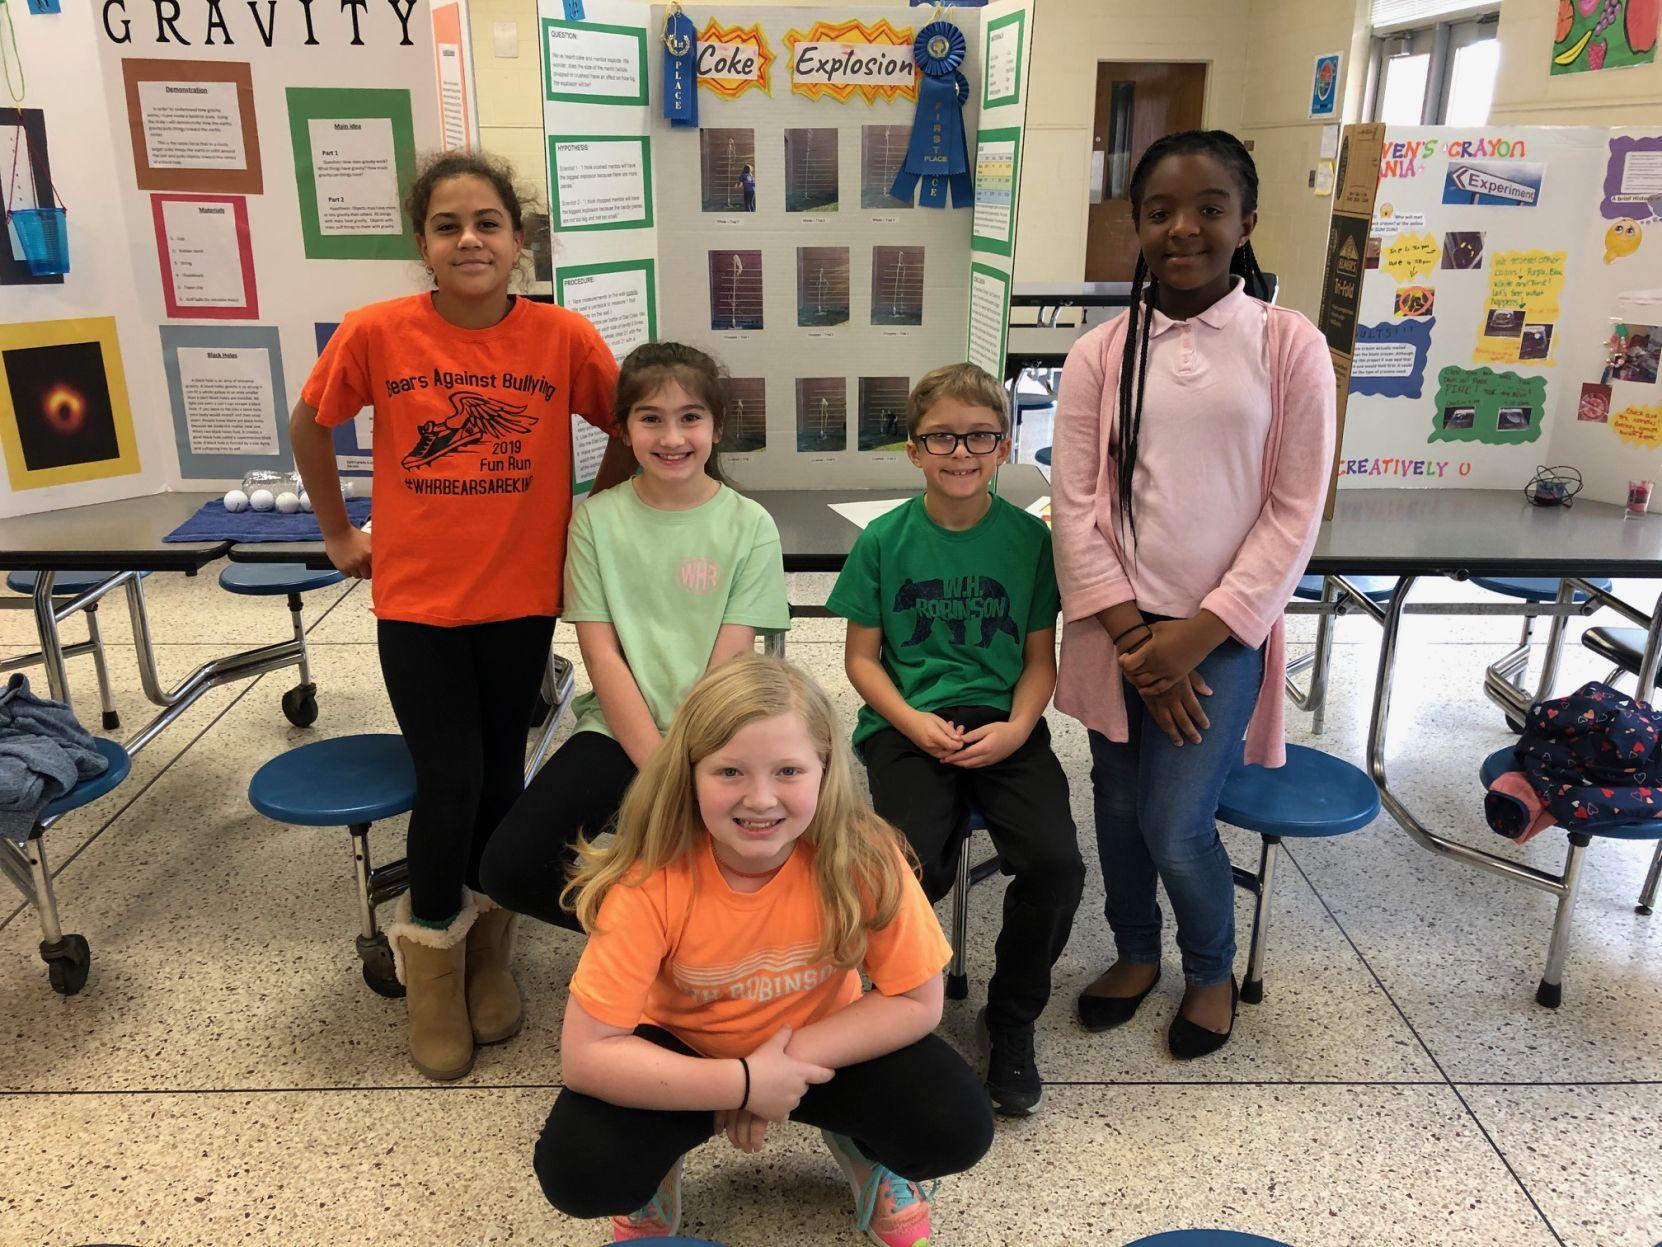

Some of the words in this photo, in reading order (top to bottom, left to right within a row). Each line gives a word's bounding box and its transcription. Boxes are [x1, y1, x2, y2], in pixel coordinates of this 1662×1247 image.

[103, 0, 417, 47] GRAVITY
[696, 43, 755, 78] Coke
[795, 46, 913, 83] Explosion
[674, 60, 685, 111] PLACE
[334, 123, 348, 131] Main
[1467, 174, 1537, 201] Experiment
[434, 368, 497, 389] Against
[502, 373, 556, 402] Bullying
[492, 440, 522, 455] 2019
[480, 458, 504, 472] Fun
[508, 456, 531, 470] Run
[1338, 458, 1449, 478] CREATIVELY
[916, 597, 1006, 622] ROBINSON
